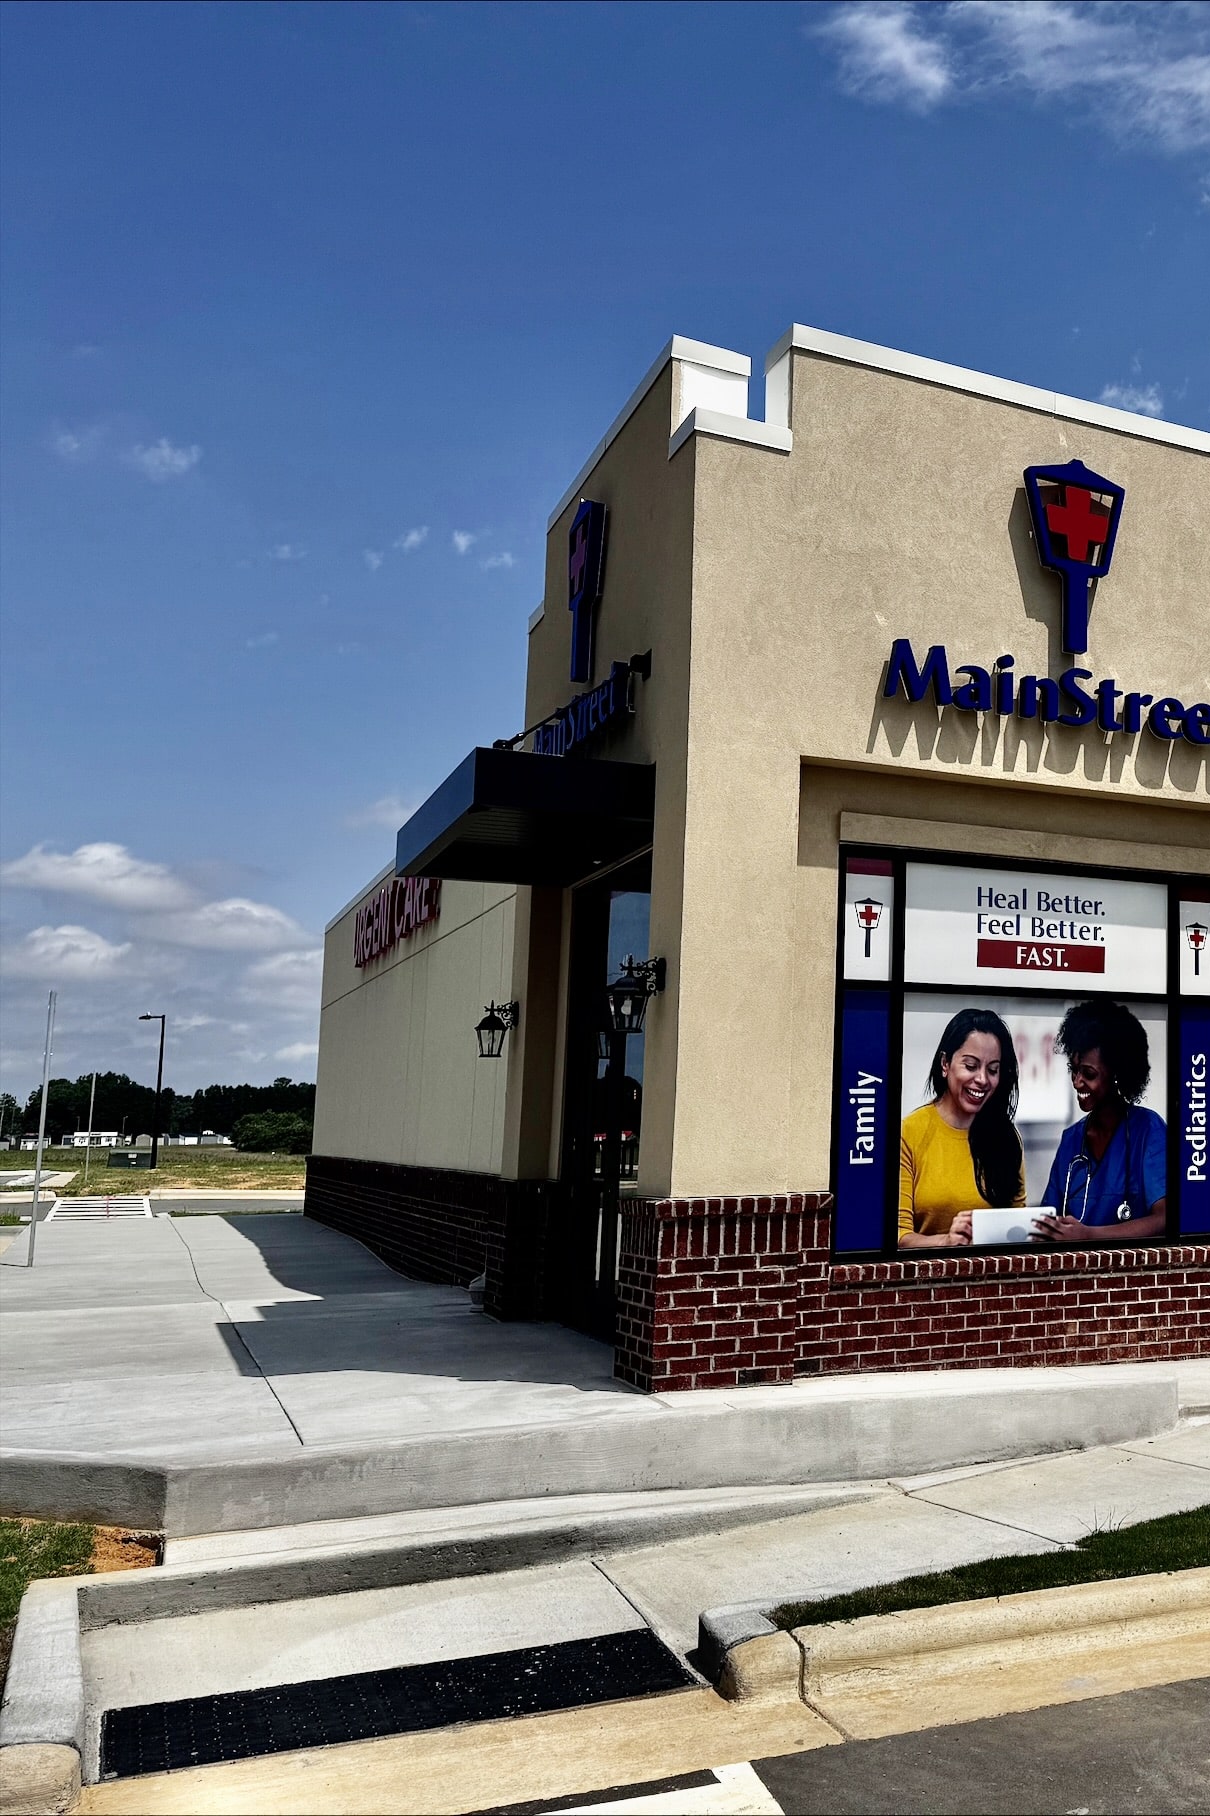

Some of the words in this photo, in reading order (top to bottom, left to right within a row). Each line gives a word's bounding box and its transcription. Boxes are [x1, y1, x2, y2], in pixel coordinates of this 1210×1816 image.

[354, 881, 394, 966] URGENT
[977, 886, 1027, 911] Heal
[1036, 891, 1106, 916] Better.
[977, 912, 1021, 936] Feel
[1031, 916, 1105, 942] Better.
[1016, 945, 1069, 968] FAST.
[848, 1070, 883, 1165] Family
[1185, 1053, 1207, 1181] Pediatrics
